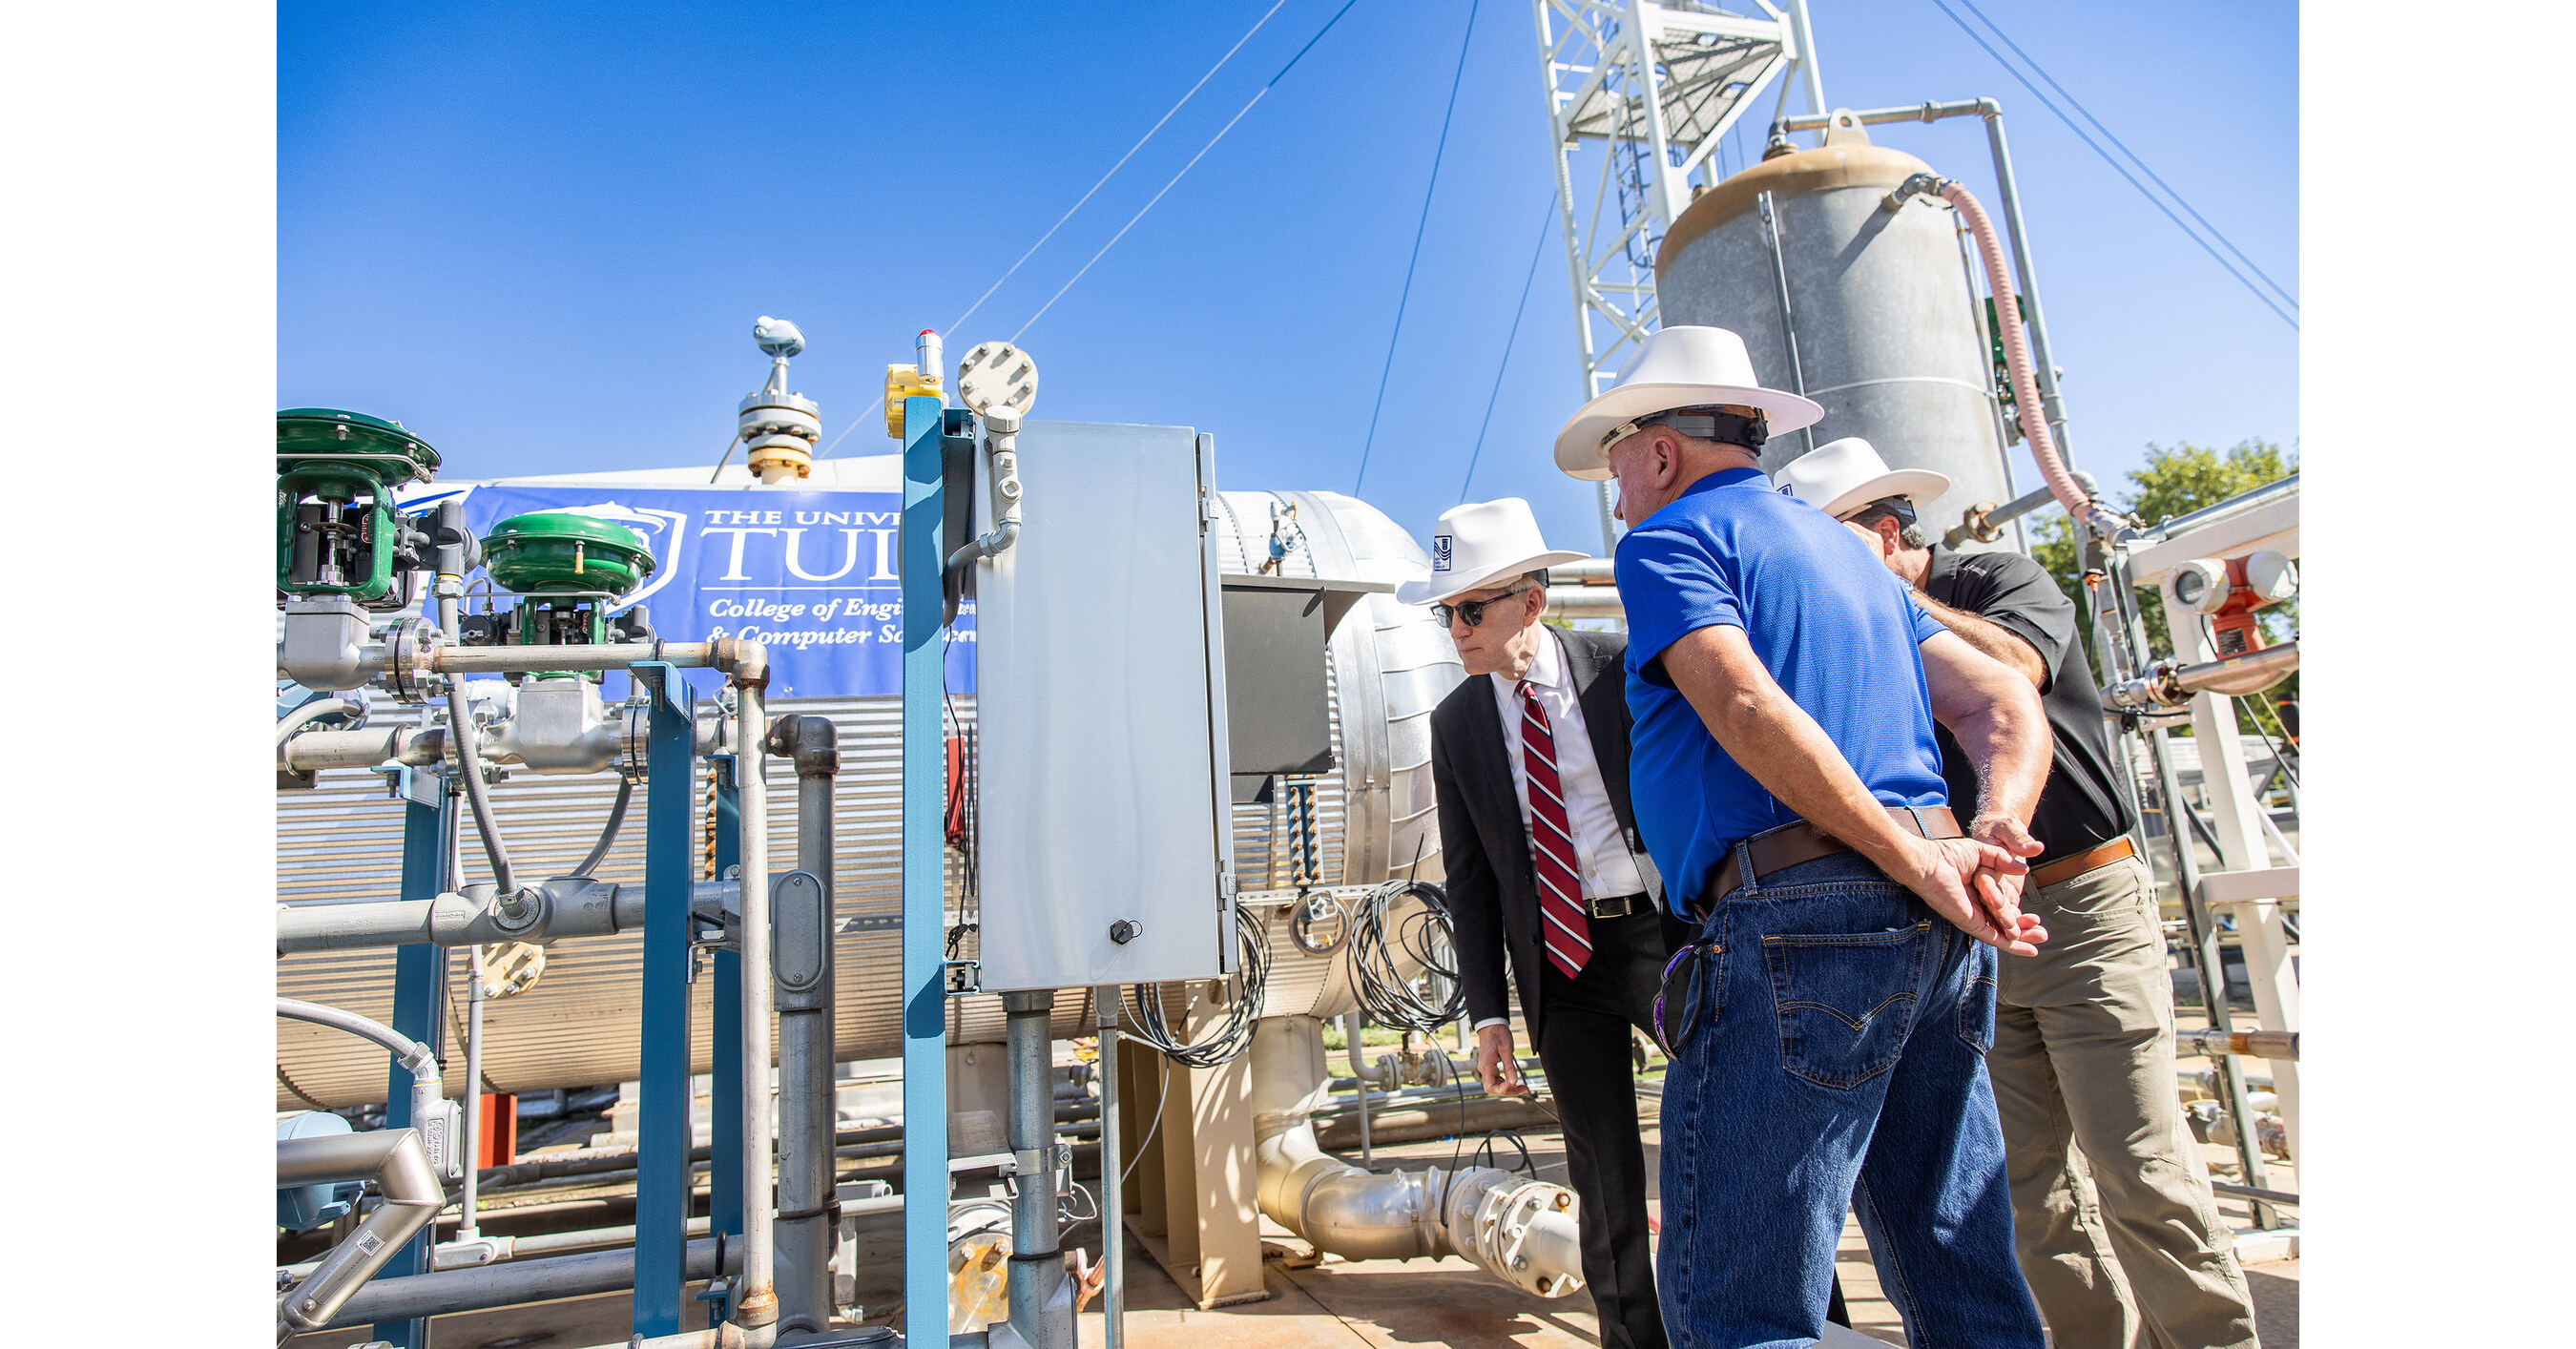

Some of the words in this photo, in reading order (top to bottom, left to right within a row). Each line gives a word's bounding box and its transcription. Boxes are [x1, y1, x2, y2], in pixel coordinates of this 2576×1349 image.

[705, 510, 782, 525] THE
[709, 597, 806, 623] College
[811, 597, 842, 622] of
[842, 597, 904, 622] Engi
[706, 626, 731, 643] &
[737, 625, 873, 651] Computer
